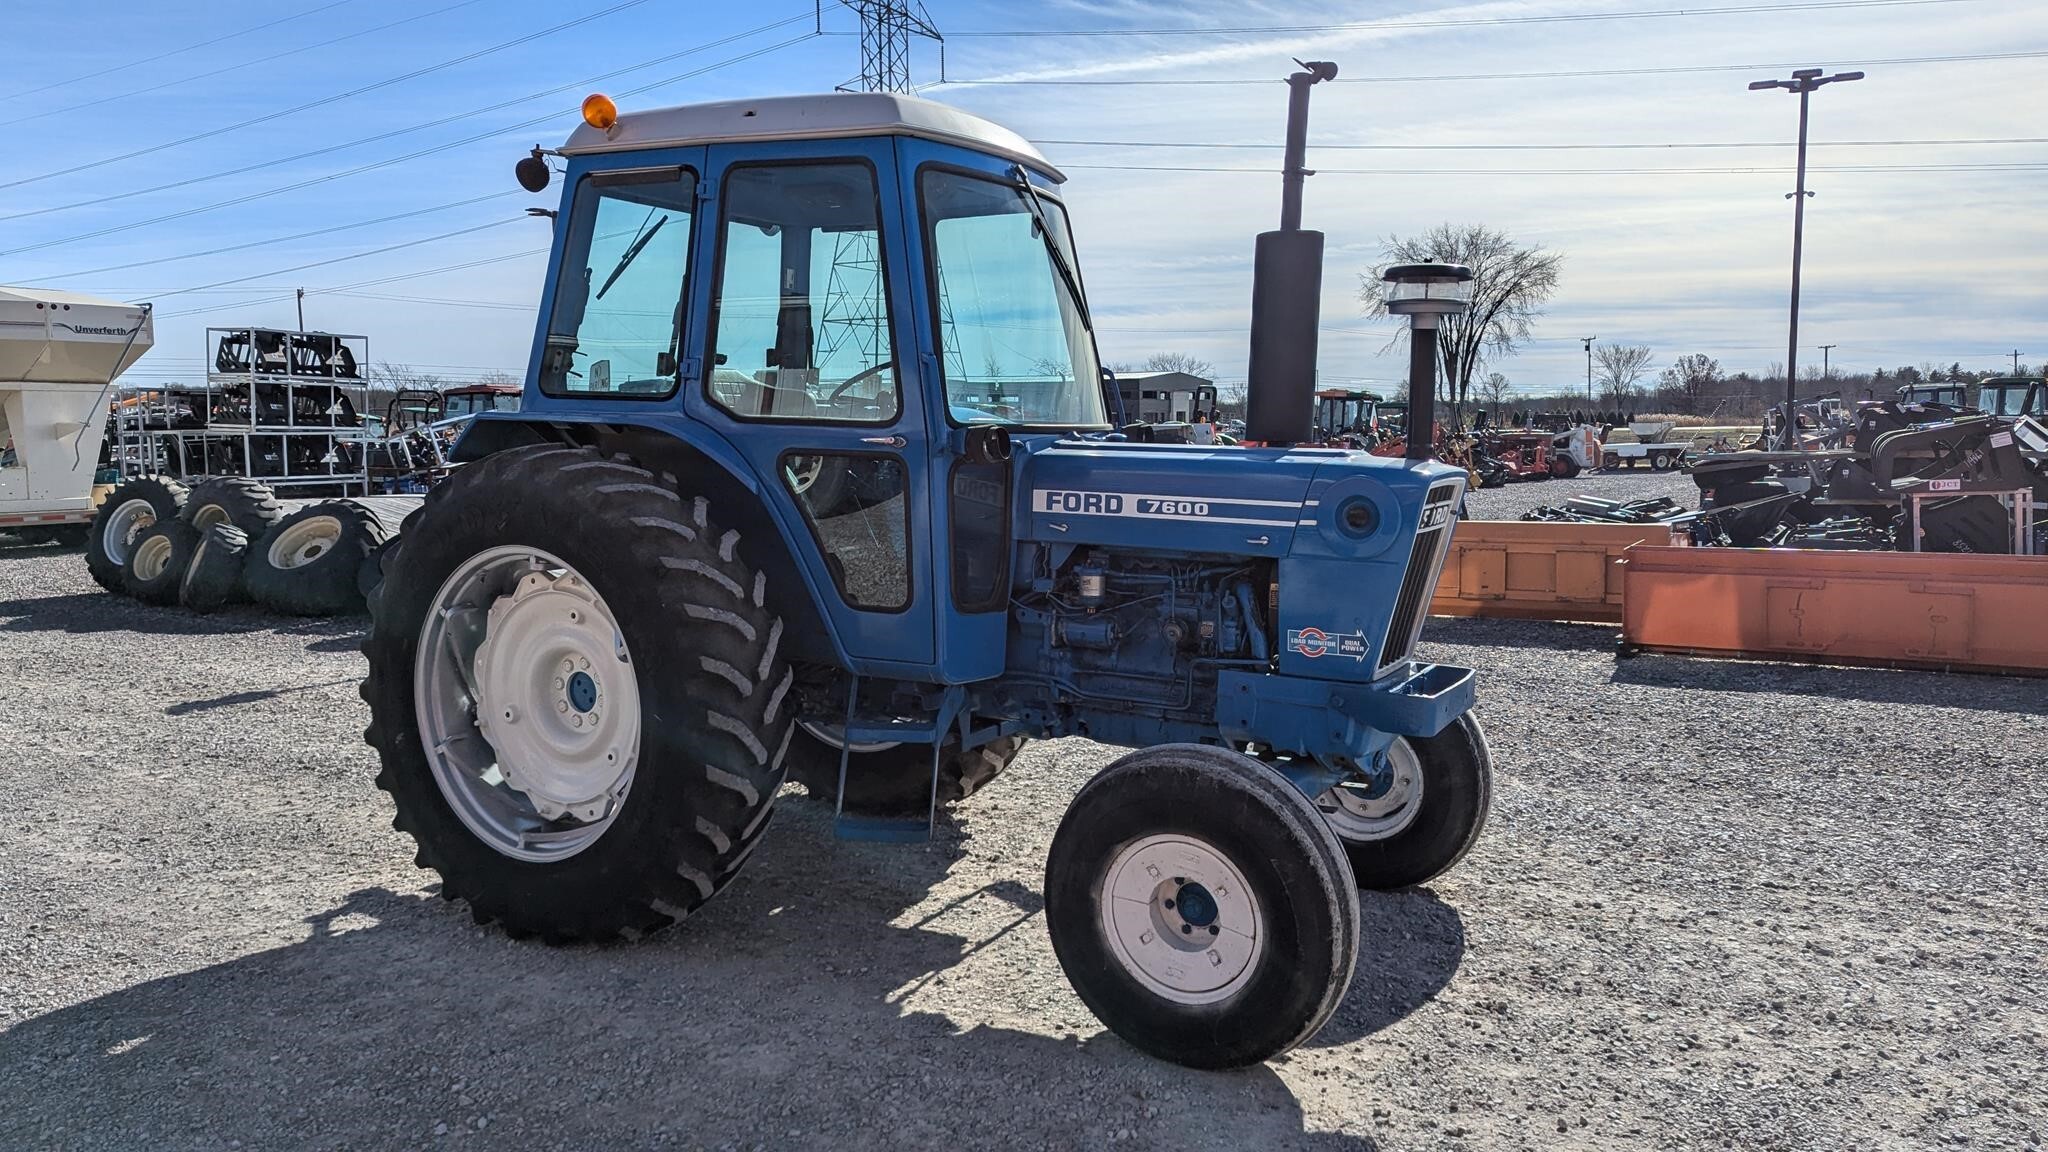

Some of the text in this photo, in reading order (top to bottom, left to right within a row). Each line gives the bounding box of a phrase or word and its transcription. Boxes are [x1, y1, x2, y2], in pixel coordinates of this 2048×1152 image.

[74, 325, 127, 335] Unverferth
[1046, 491, 1209, 516] FORD 7600
[1290, 637, 1336, 647] LOAD MONITOR
